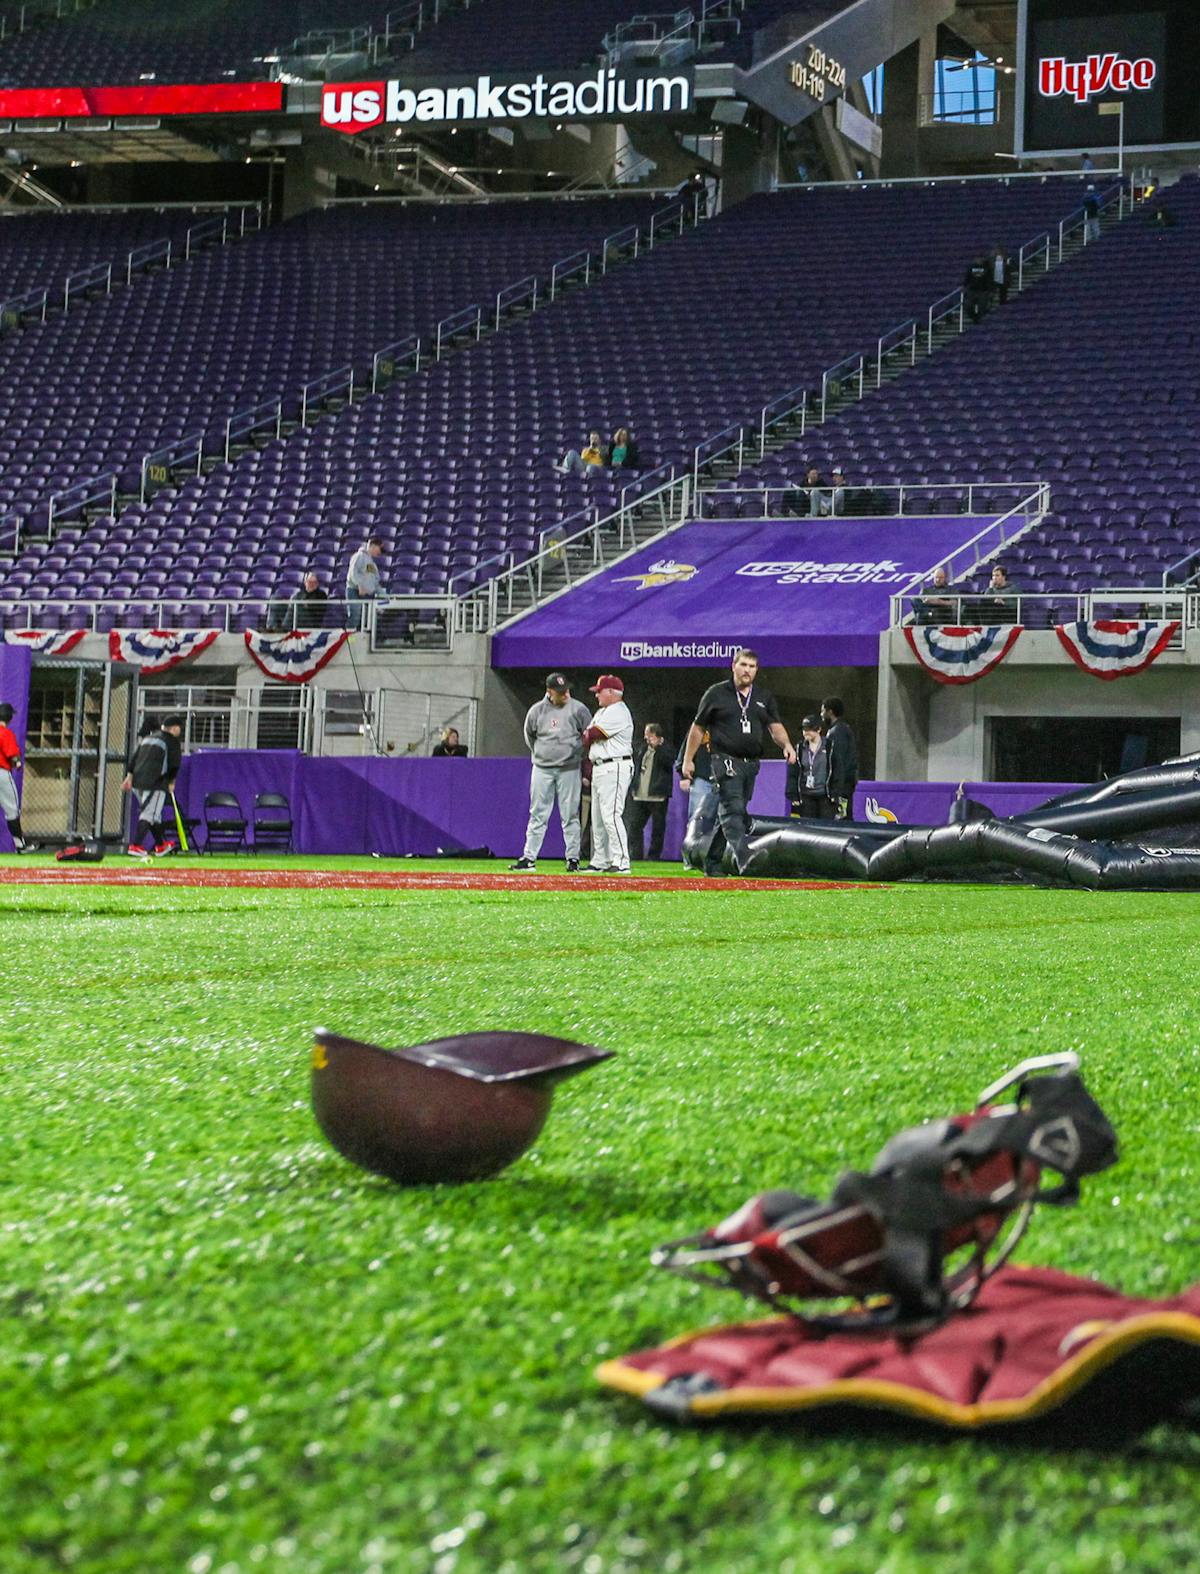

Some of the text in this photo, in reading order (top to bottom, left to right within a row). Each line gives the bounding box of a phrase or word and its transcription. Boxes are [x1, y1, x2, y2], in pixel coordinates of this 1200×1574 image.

[791, 61, 825, 101] 101-119
[808, 43, 846, 89] 201-224
[149, 464, 167, 482] 120
